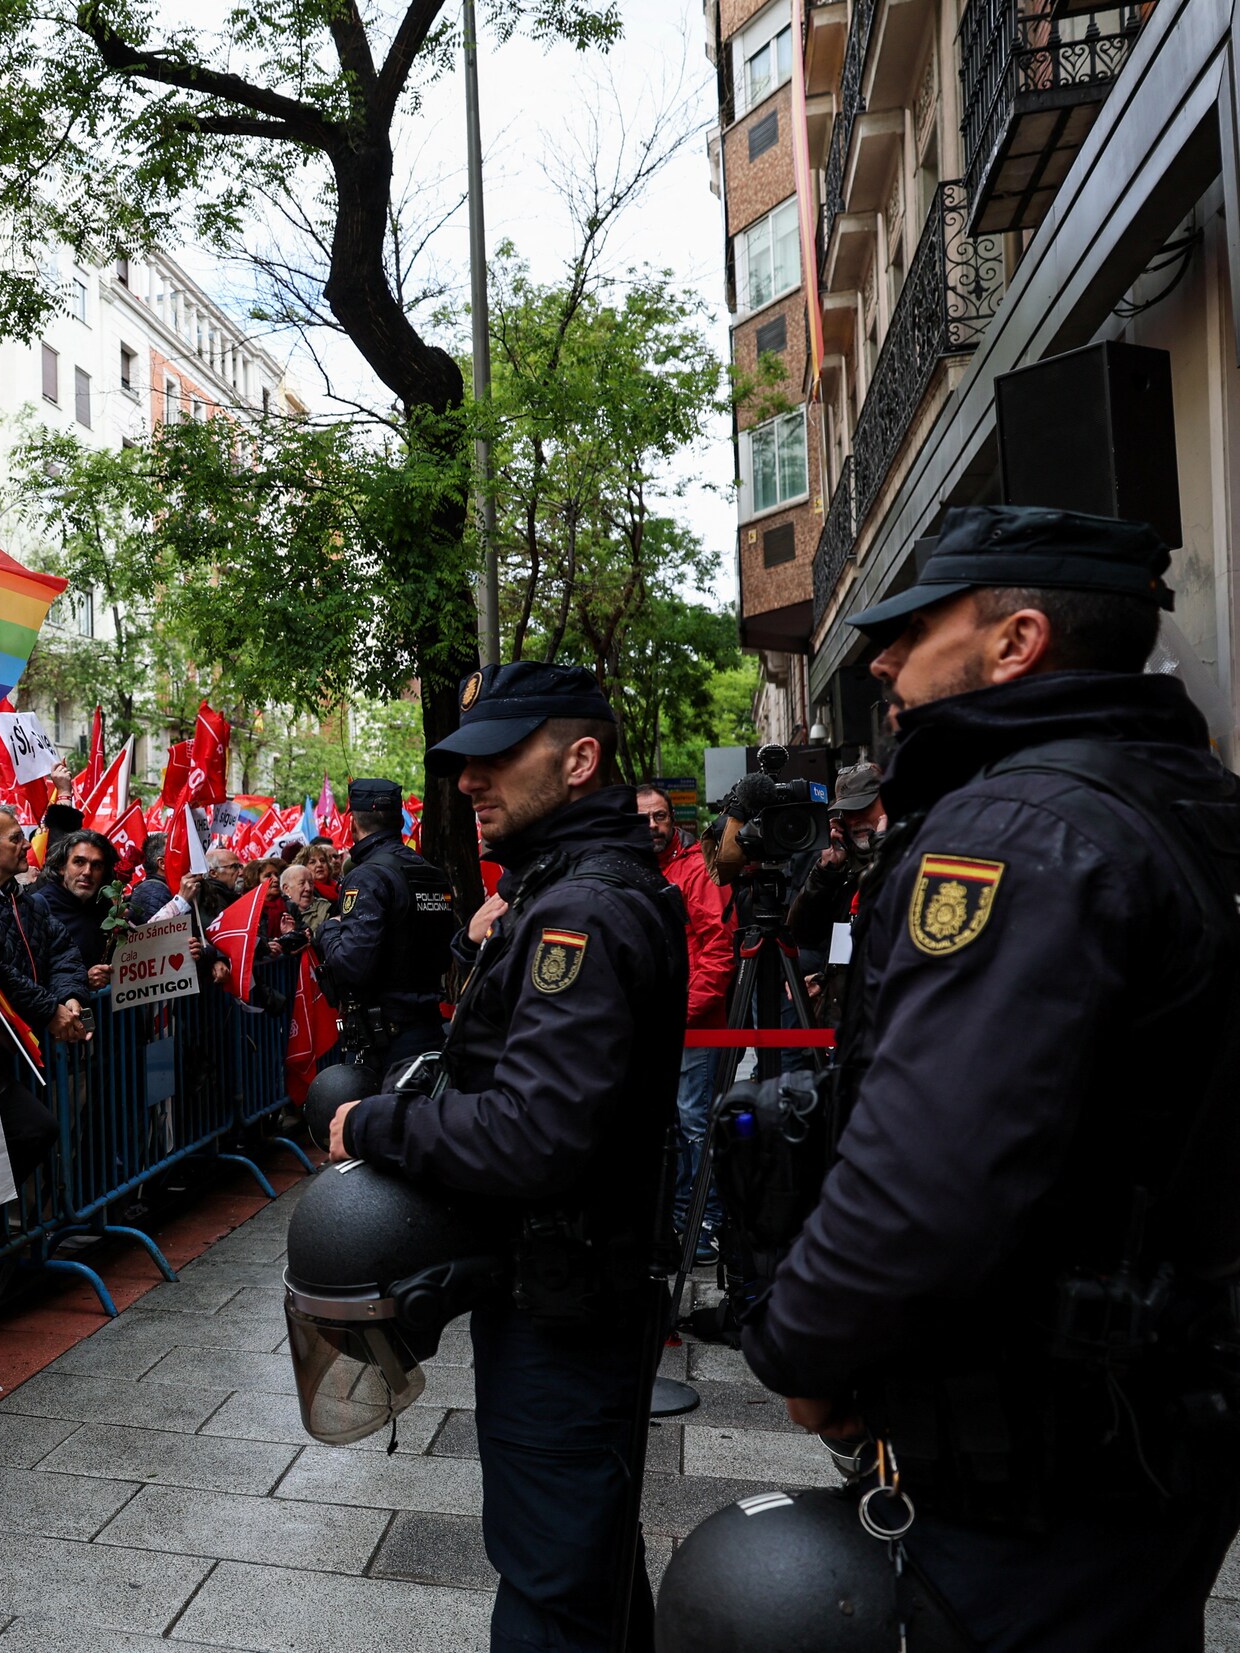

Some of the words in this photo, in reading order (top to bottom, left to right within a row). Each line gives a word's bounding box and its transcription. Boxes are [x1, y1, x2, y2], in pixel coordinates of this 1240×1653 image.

[813, 786, 825, 799] tve
[417, 902, 452, 911] NACIONAL
[146, 922, 188, 939] Sánchez
[121, 950, 138, 963] Cala
[119, 958, 157, 984] PSOE
[115, 977, 193, 1004] CONTIGO!
